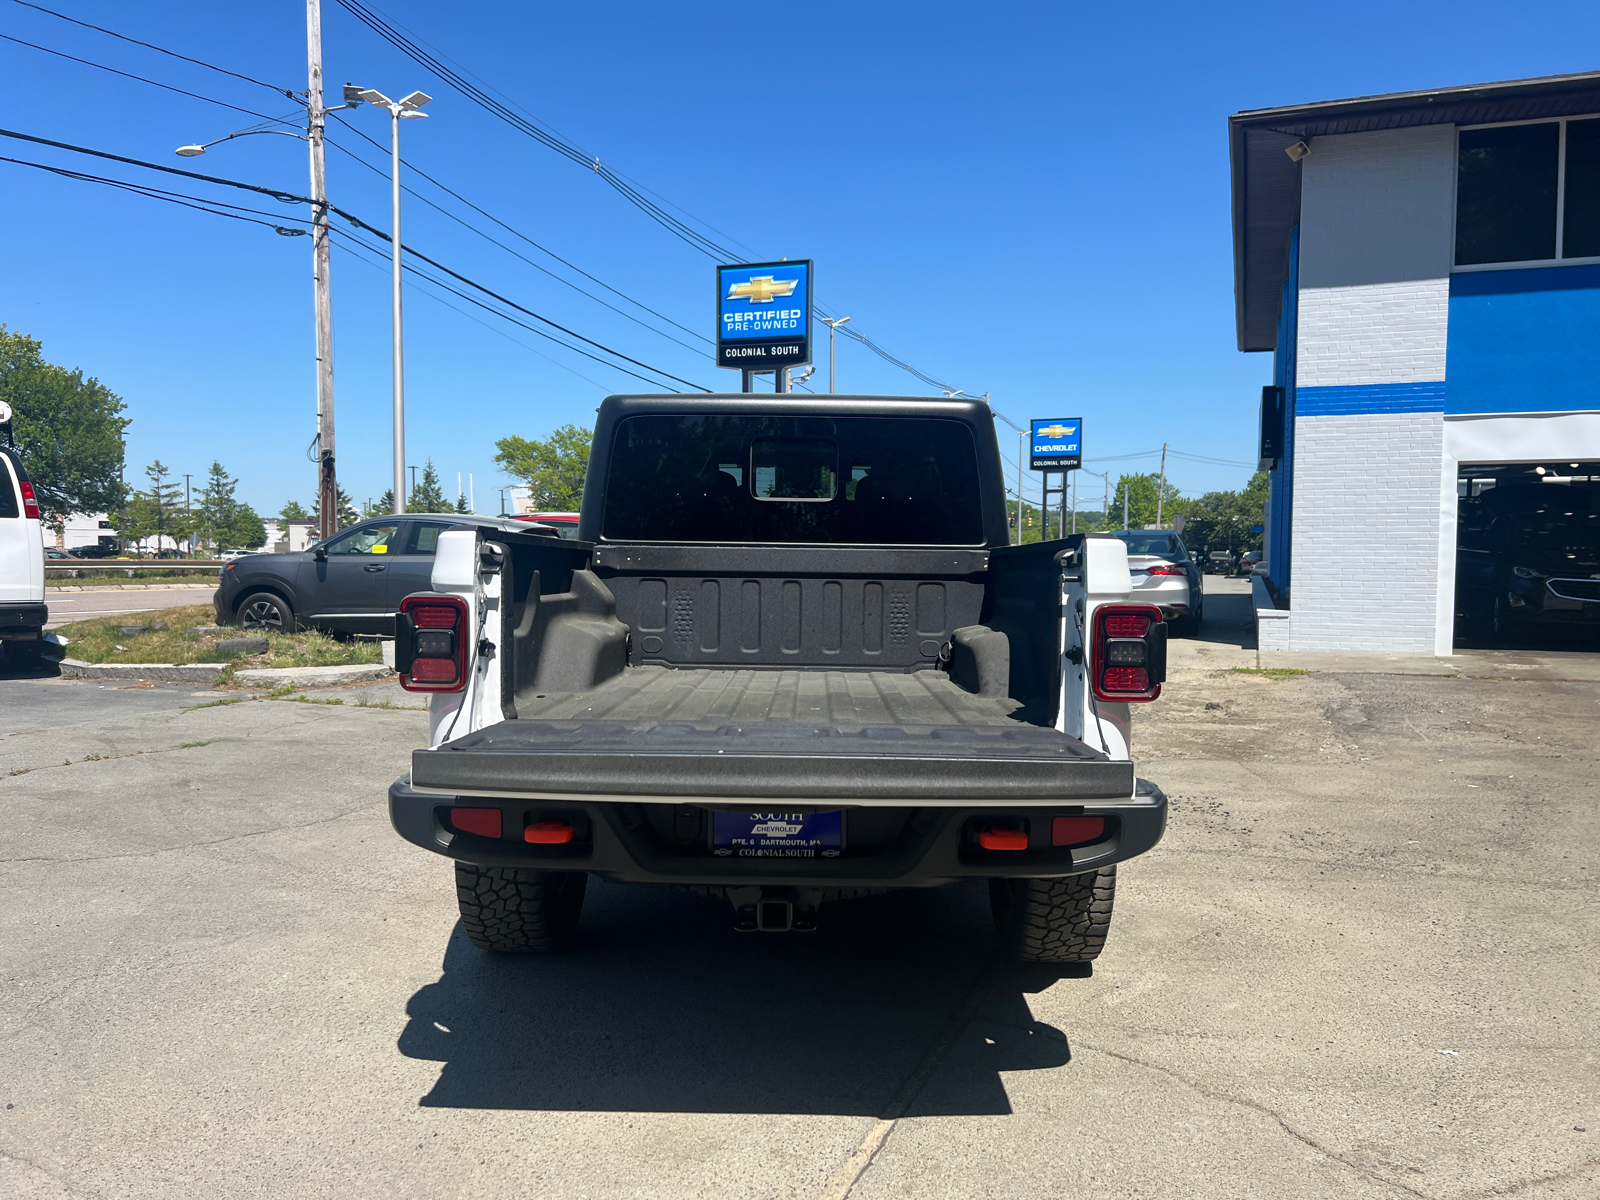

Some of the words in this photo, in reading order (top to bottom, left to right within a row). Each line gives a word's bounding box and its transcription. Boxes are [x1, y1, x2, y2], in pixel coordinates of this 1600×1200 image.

[723, 309, 801, 322] CERTIFIED
[727, 319, 797, 331] PRE-OWNED
[725, 347, 767, 357] COLONIAL
[771, 346, 799, 355] SOUTH
[1034, 444, 1078, 452] CHEVROLET
[760, 839, 808, 847] DARTMOUTH,
[739, 848, 785, 857] COLONIAL
[785, 849, 815, 857] SOUTH
